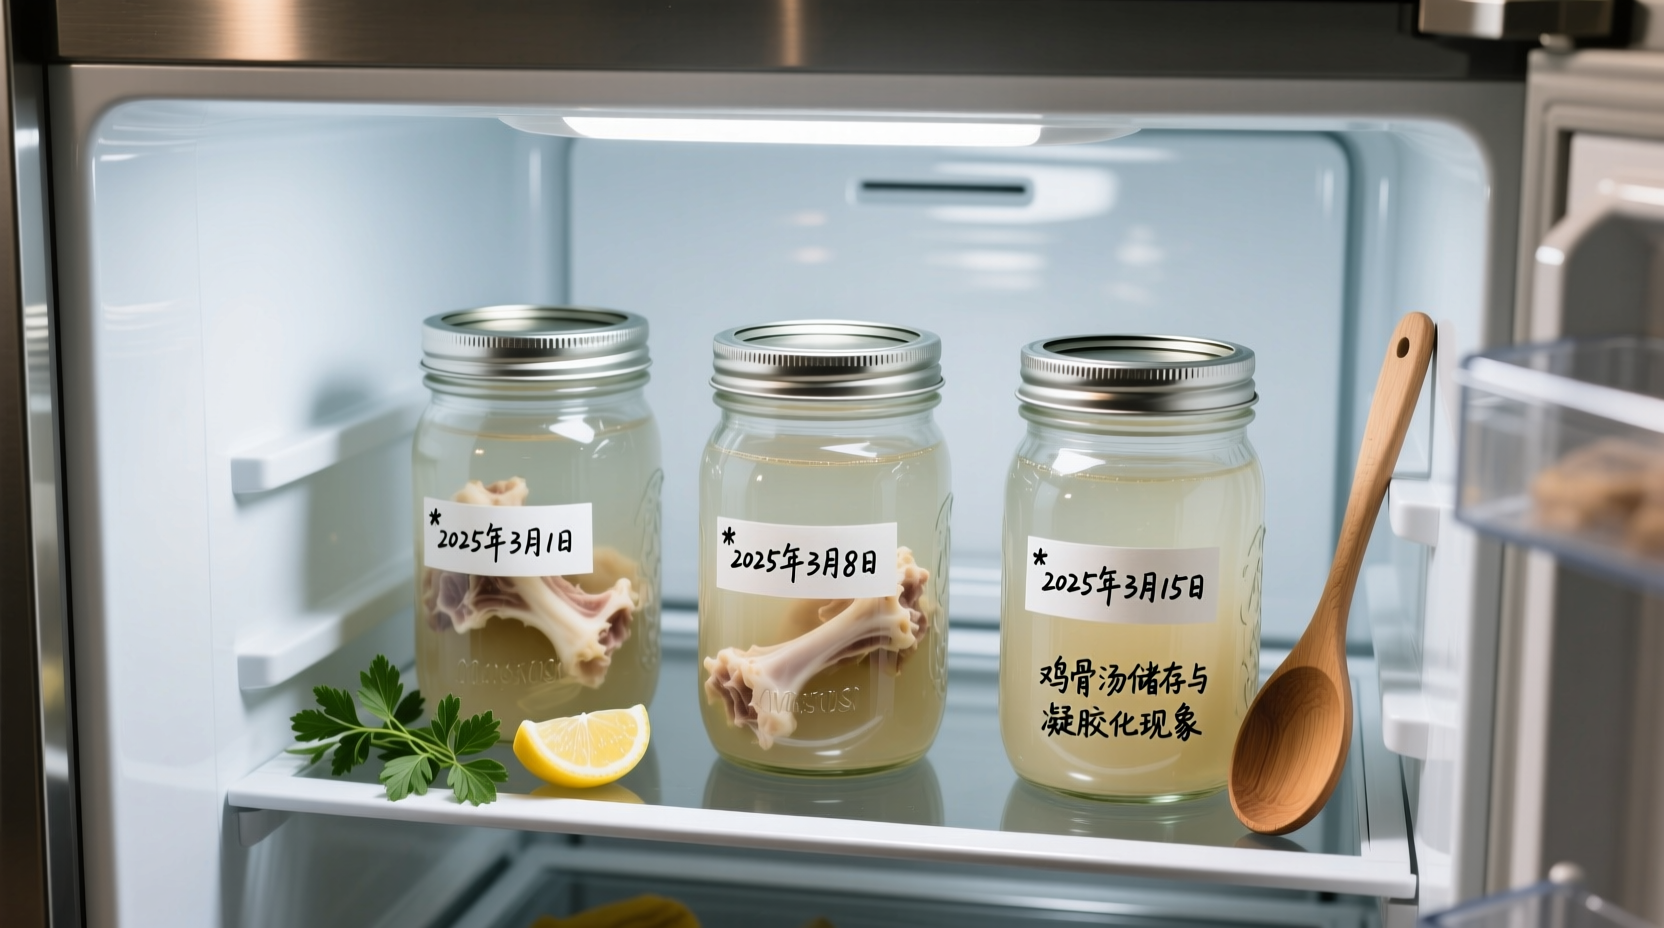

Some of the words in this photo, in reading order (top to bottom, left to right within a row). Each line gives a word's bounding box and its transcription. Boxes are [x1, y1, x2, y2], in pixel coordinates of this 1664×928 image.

[1039, 655, 1208, 698] 鸡骨汤储存与
[1041, 701, 1203, 742] 凝胶化现象
